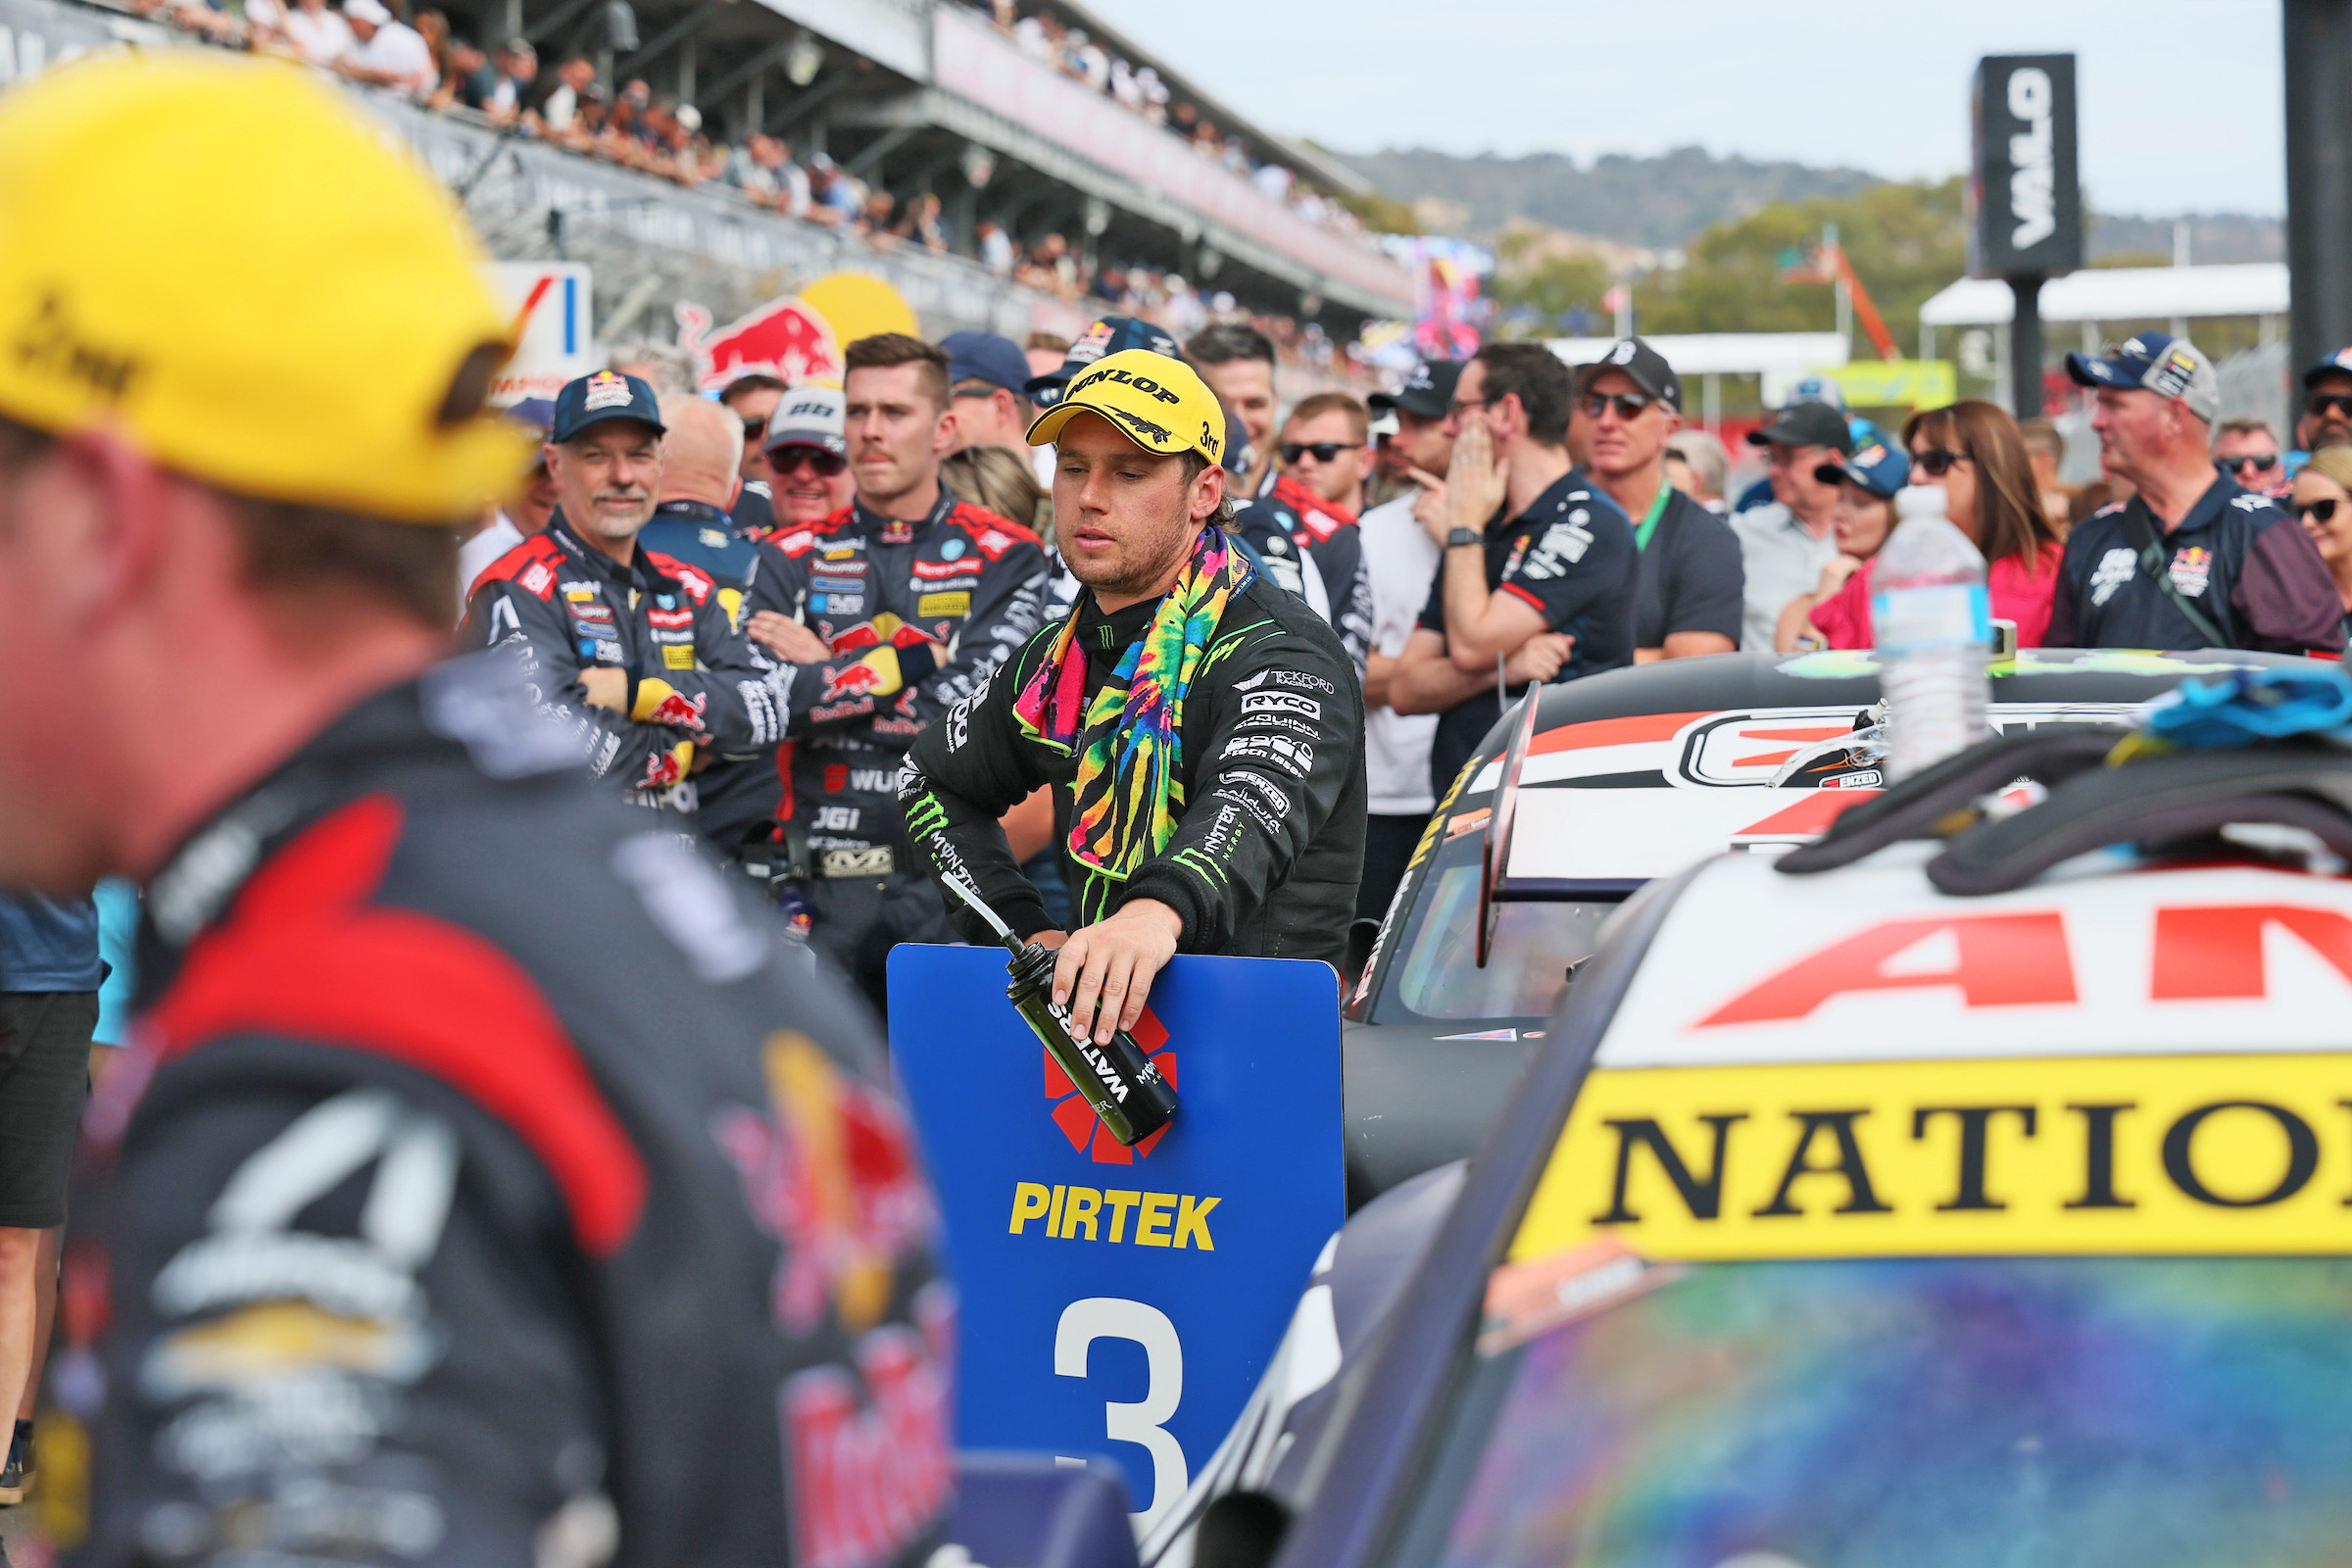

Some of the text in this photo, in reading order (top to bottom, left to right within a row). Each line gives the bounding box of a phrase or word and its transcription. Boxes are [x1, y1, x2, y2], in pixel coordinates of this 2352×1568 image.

[1064, 368, 1180, 405] DUNLOP
[1200, 420, 1219, 457] 3rd
[1270, 670, 1335, 695] TICKFORD
[1246, 695, 1317, 713] RYCO
[1247, 773, 1286, 810] ENZED
[1838, 772, 1878, 788] ENZED
[810, 806, 861, 831] JGI
[1221, 821, 1246, 861] NERGY
[1589, 1098, 2352, 1225] NATIO
[1008, 1181, 1223, 1251] PIRTEK
[1054, 1297, 1190, 1551] 3
